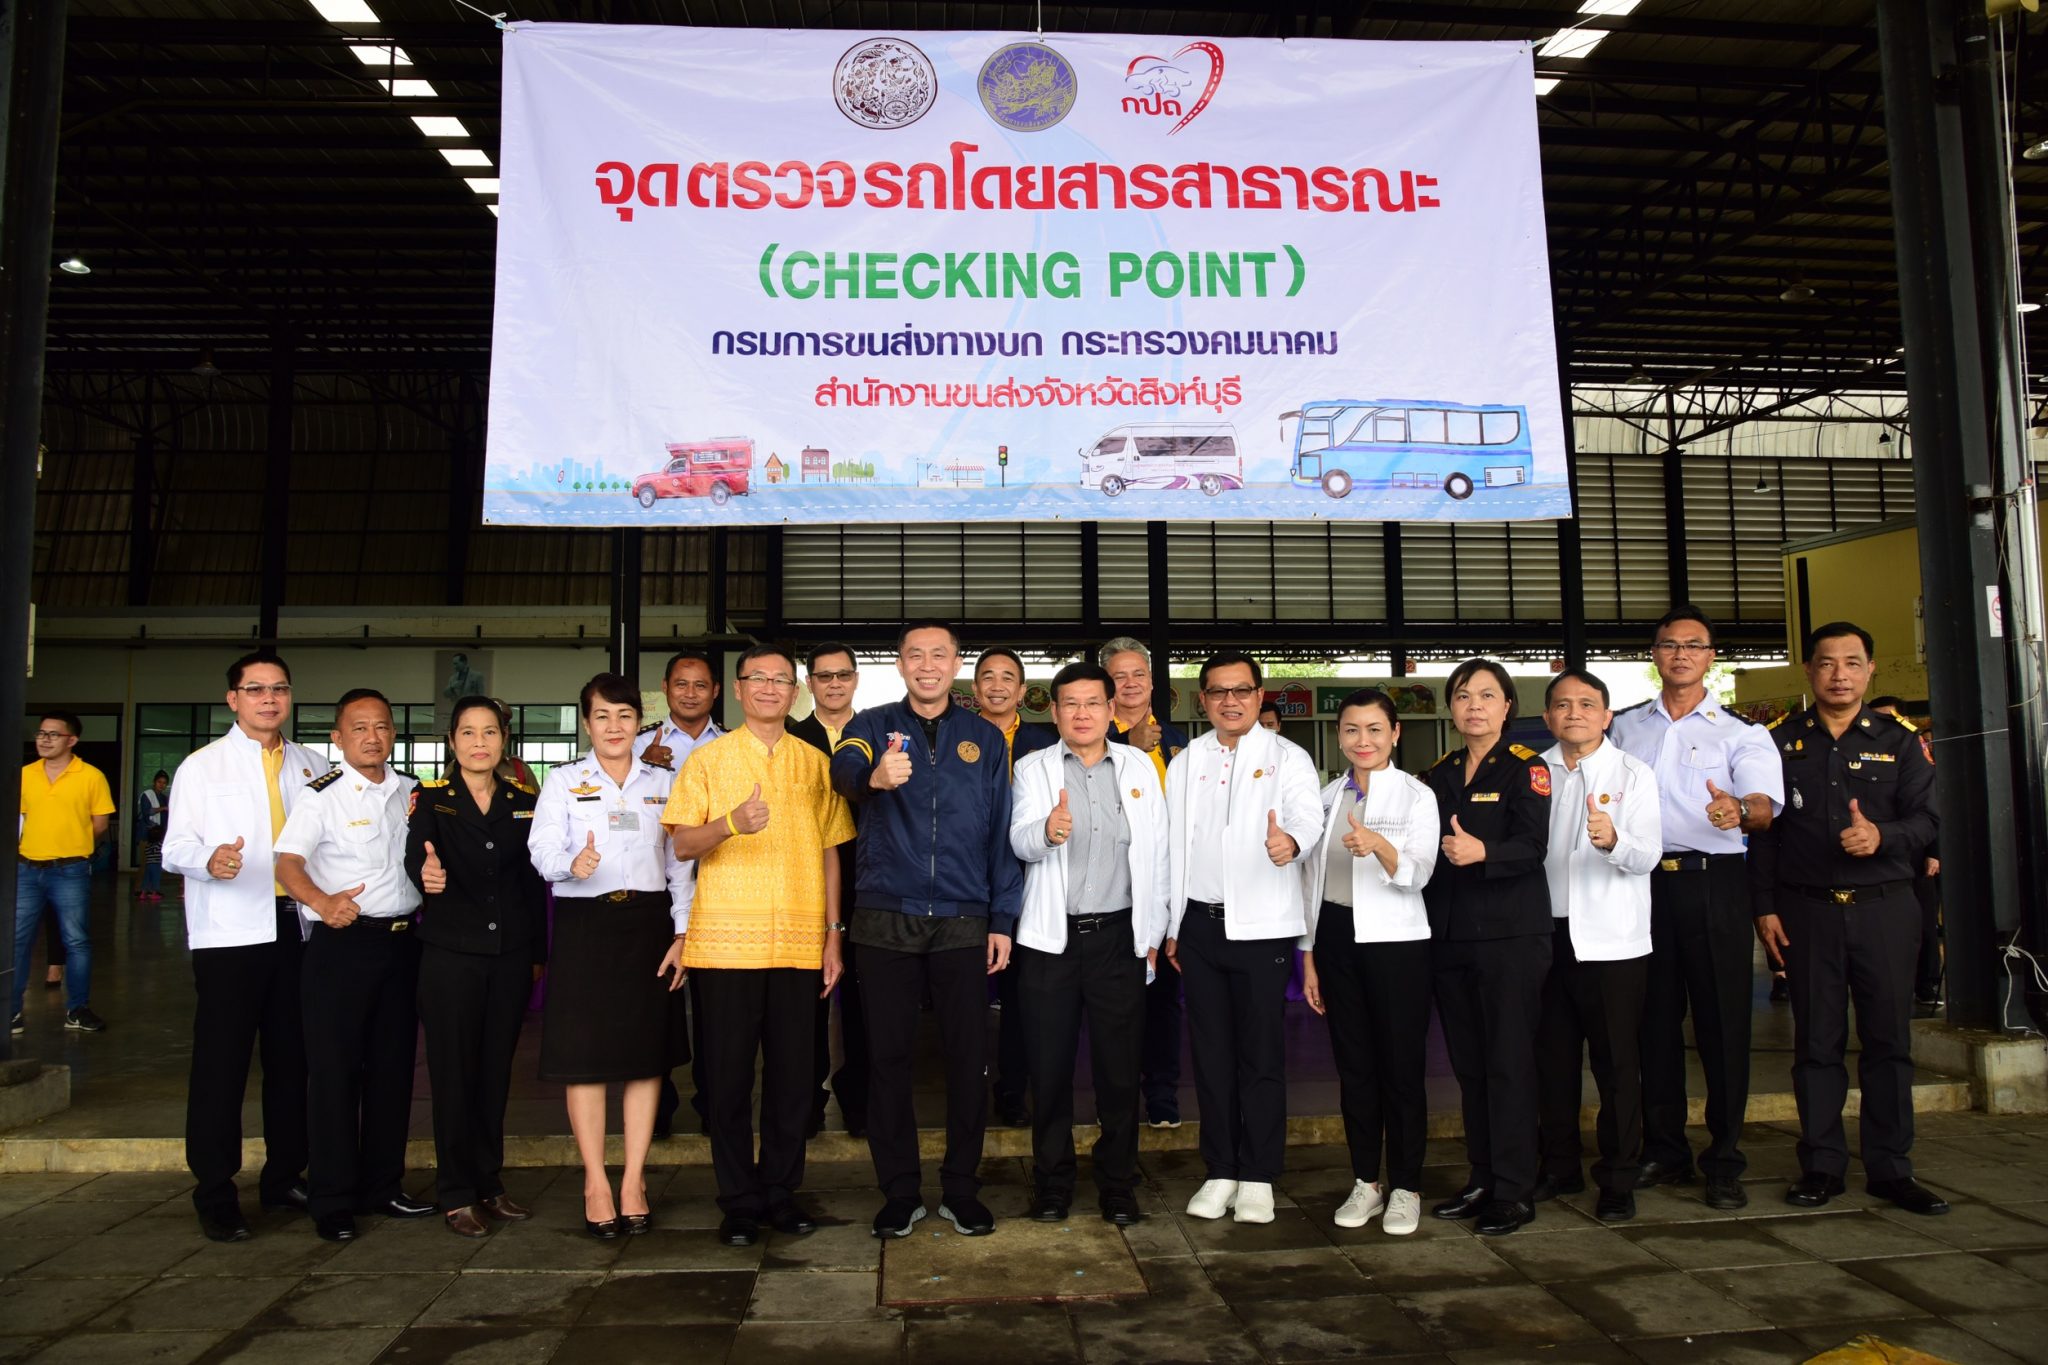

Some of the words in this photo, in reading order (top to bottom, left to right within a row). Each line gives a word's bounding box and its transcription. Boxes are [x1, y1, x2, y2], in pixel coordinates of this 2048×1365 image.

[1121, 92, 1182, 116] กปถ
[759, 243, 1081, 299] (CHECKING
[1109, 244, 1306, 298] POINT)
[712, 323, 1043, 356] กรมการขนส่งทางบก
[1061, 330, 1338, 355] กระทรวงคมนาคม
[814, 375, 1242, 413] สำนักงานขนส่งจังหวัดสิงห์บุรี
